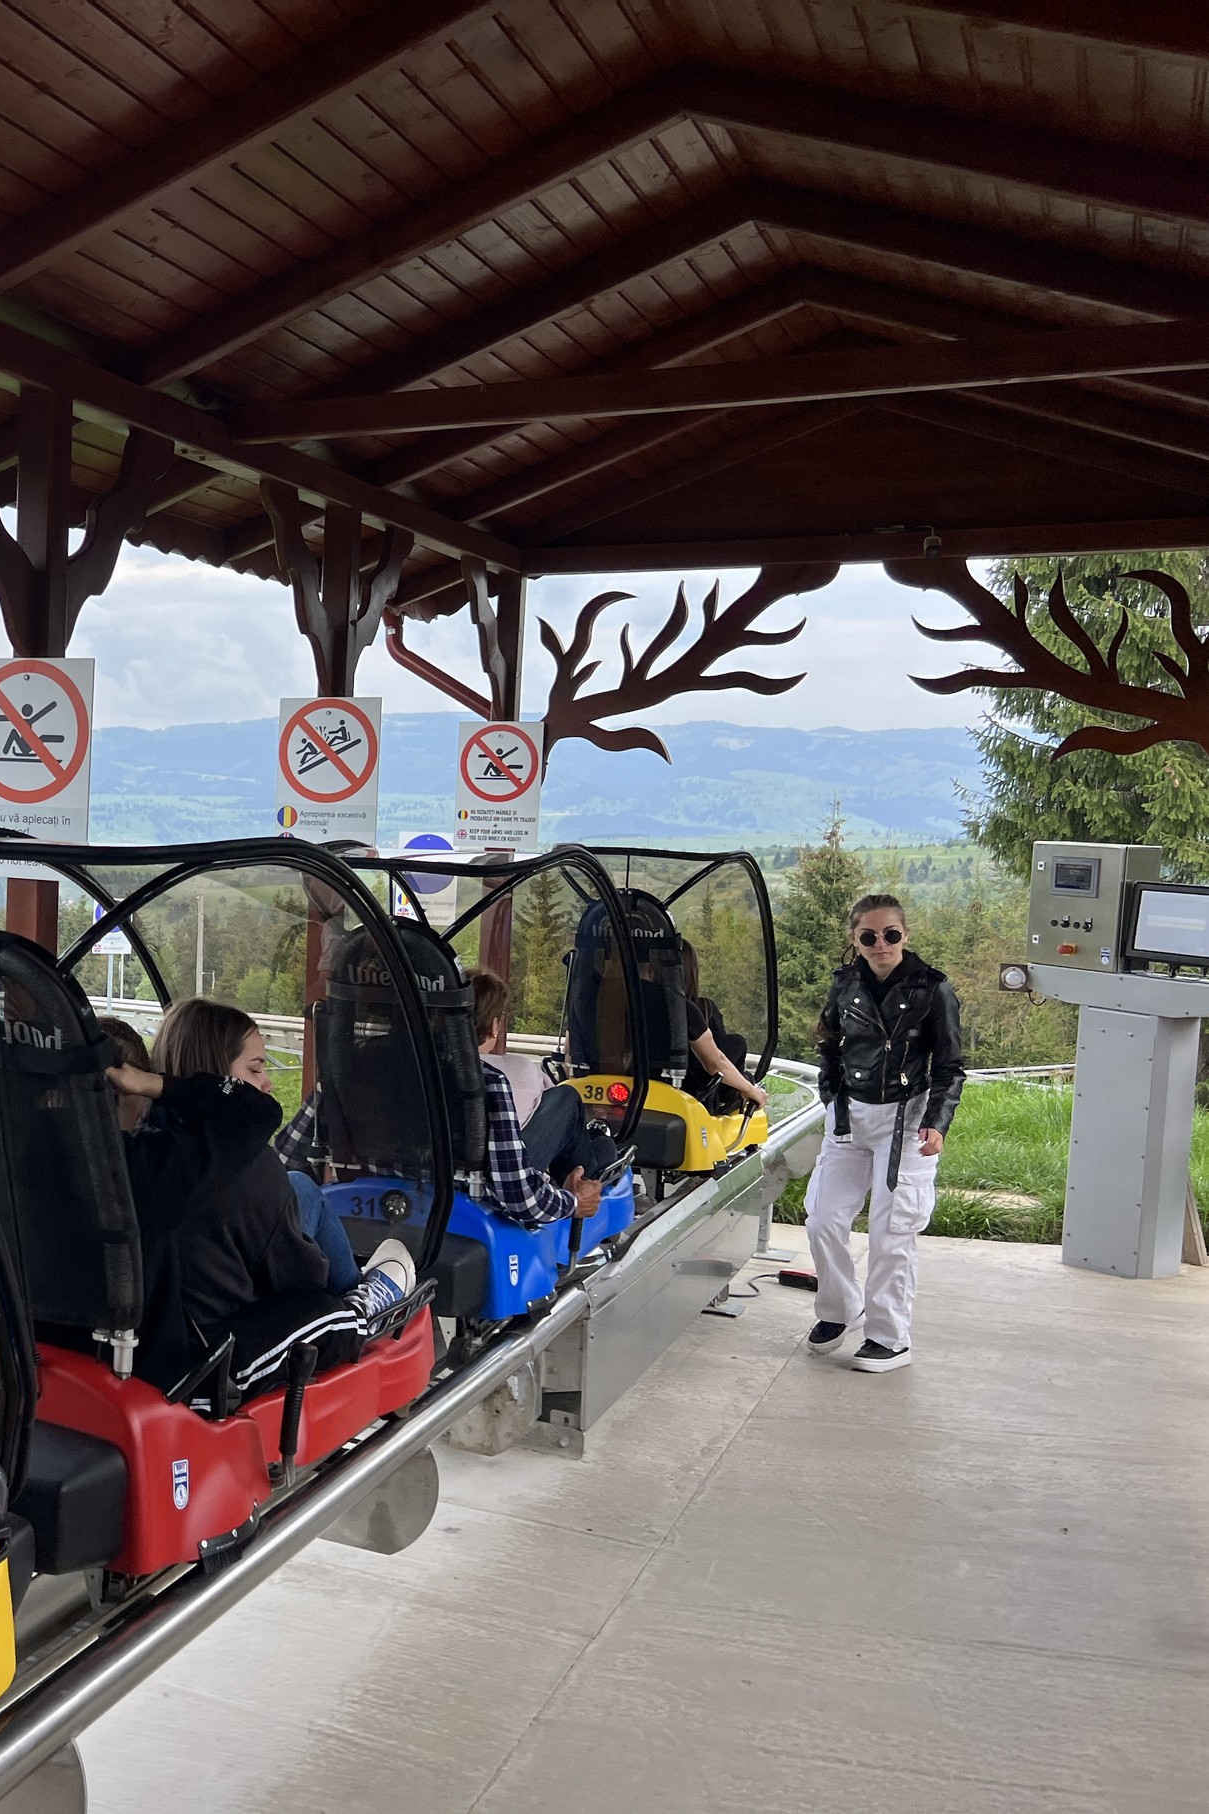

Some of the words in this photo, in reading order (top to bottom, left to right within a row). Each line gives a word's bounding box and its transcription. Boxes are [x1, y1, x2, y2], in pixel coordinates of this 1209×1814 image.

[8, 812, 20, 823] vă
[22, 813, 59, 827] aplecați
[61, 815, 71, 825] în
[299, 810, 336, 819] Apropierea
[583, 1085, 604, 1101] 38
[350, 1196, 375, 1218] 31
